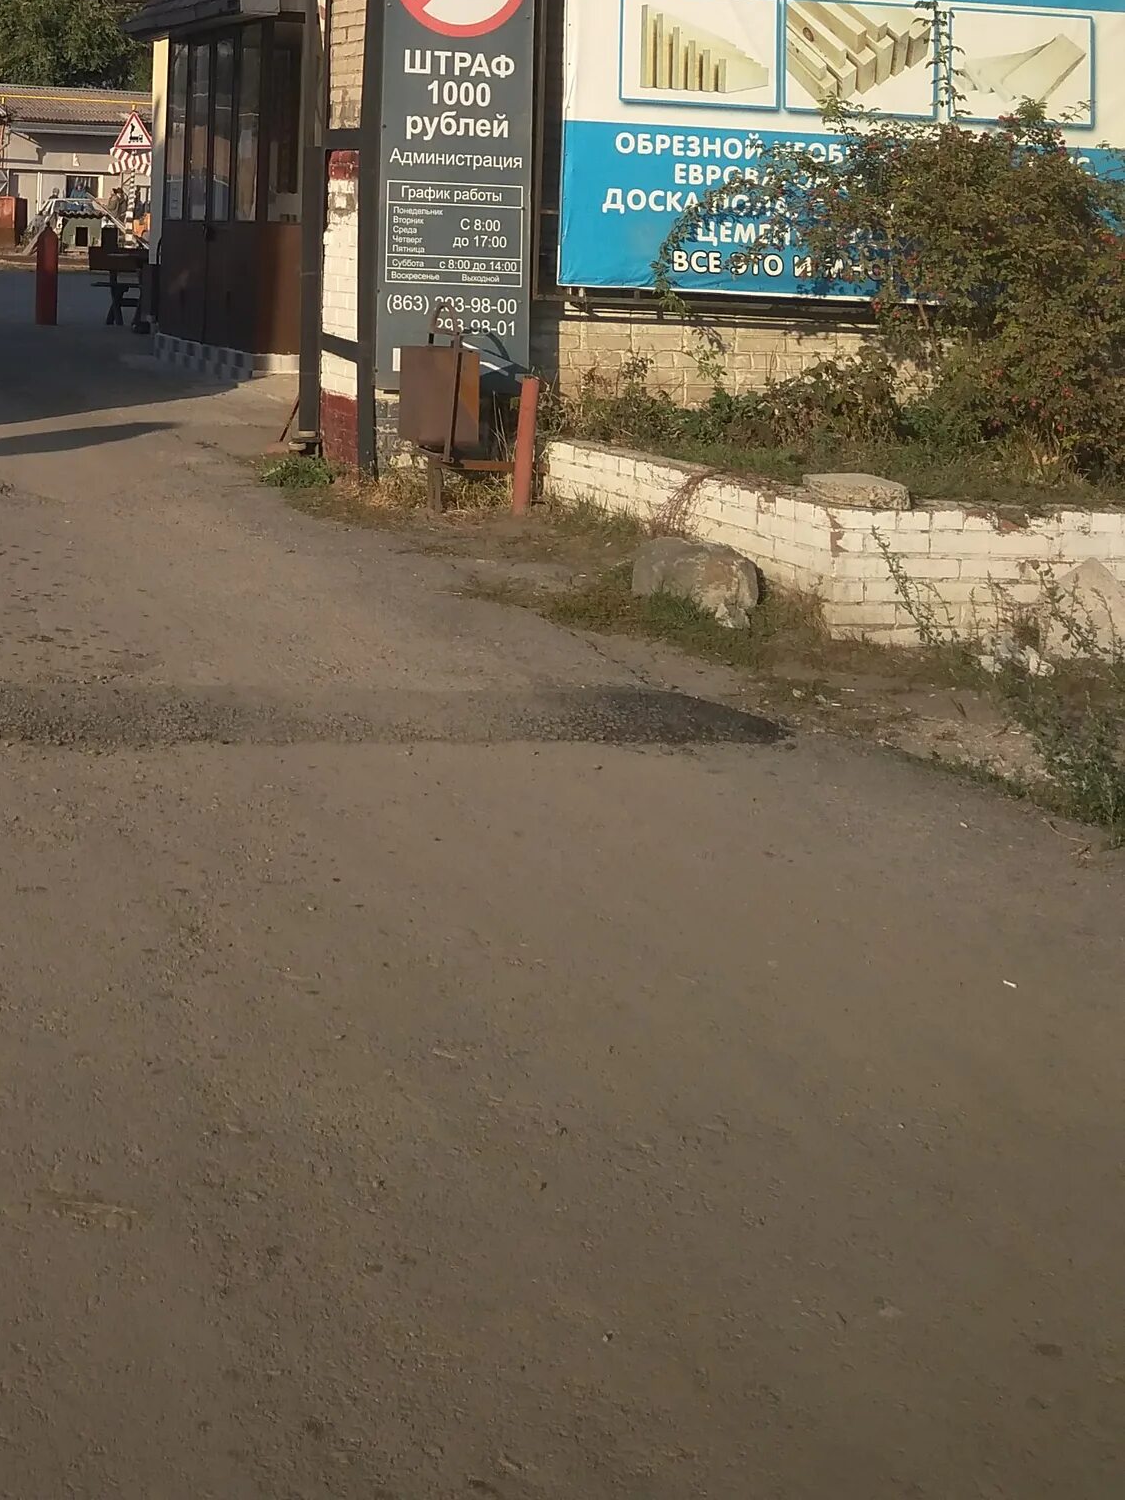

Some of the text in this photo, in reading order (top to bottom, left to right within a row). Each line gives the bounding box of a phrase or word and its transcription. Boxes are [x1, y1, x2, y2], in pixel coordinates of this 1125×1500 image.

[404, 48, 515, 78] ШТРАФ
[427, 79, 492, 107] 1000
[405, 111, 509, 141] рублей
[615, 132, 762, 160] ОБРЕЗНОЙ
[389, 147, 523, 171] Администрация
[401, 185, 502, 203] График работы
[602, 187, 700, 214] ДОСКА
[393, 206, 444, 216] Понедельник
[392, 215, 425, 225] Вторник
[460, 218, 501, 232] С 8:00
[392, 225, 418, 235] Среда
[392, 234, 423, 245] Четверг
[452, 235, 507, 248] до 17:00
[392, 244, 425, 254] Пятница
[392, 258, 518, 272] Суббота с 8:00 до 14:00
[673, 250, 722, 274] ВСЕ
[391, 271, 500, 283] Воскресенье Выходной
[386, 294, 429, 315] (863)
